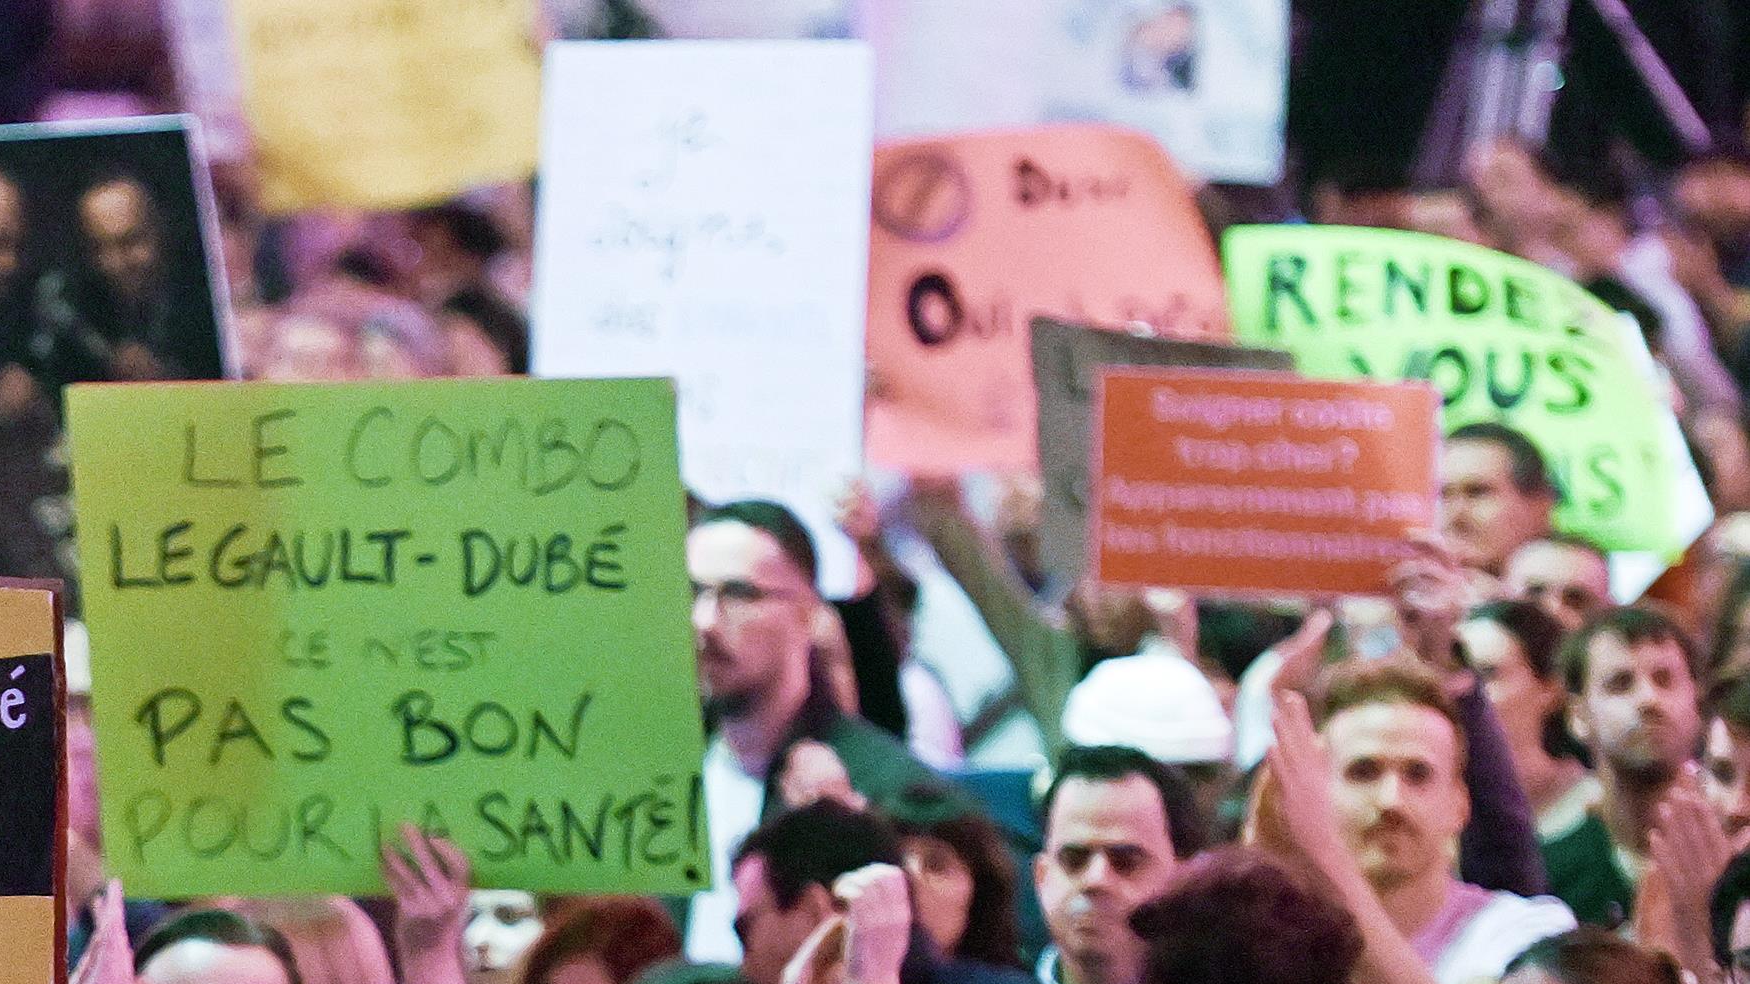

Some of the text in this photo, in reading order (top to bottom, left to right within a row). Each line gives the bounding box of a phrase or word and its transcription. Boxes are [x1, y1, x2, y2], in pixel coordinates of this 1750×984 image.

[184, 409, 304, 489] LE
[350, 406, 641, 497] COMBO
[136, 687, 592, 767] PAS BON
[124, 790, 349, 866] POUR
